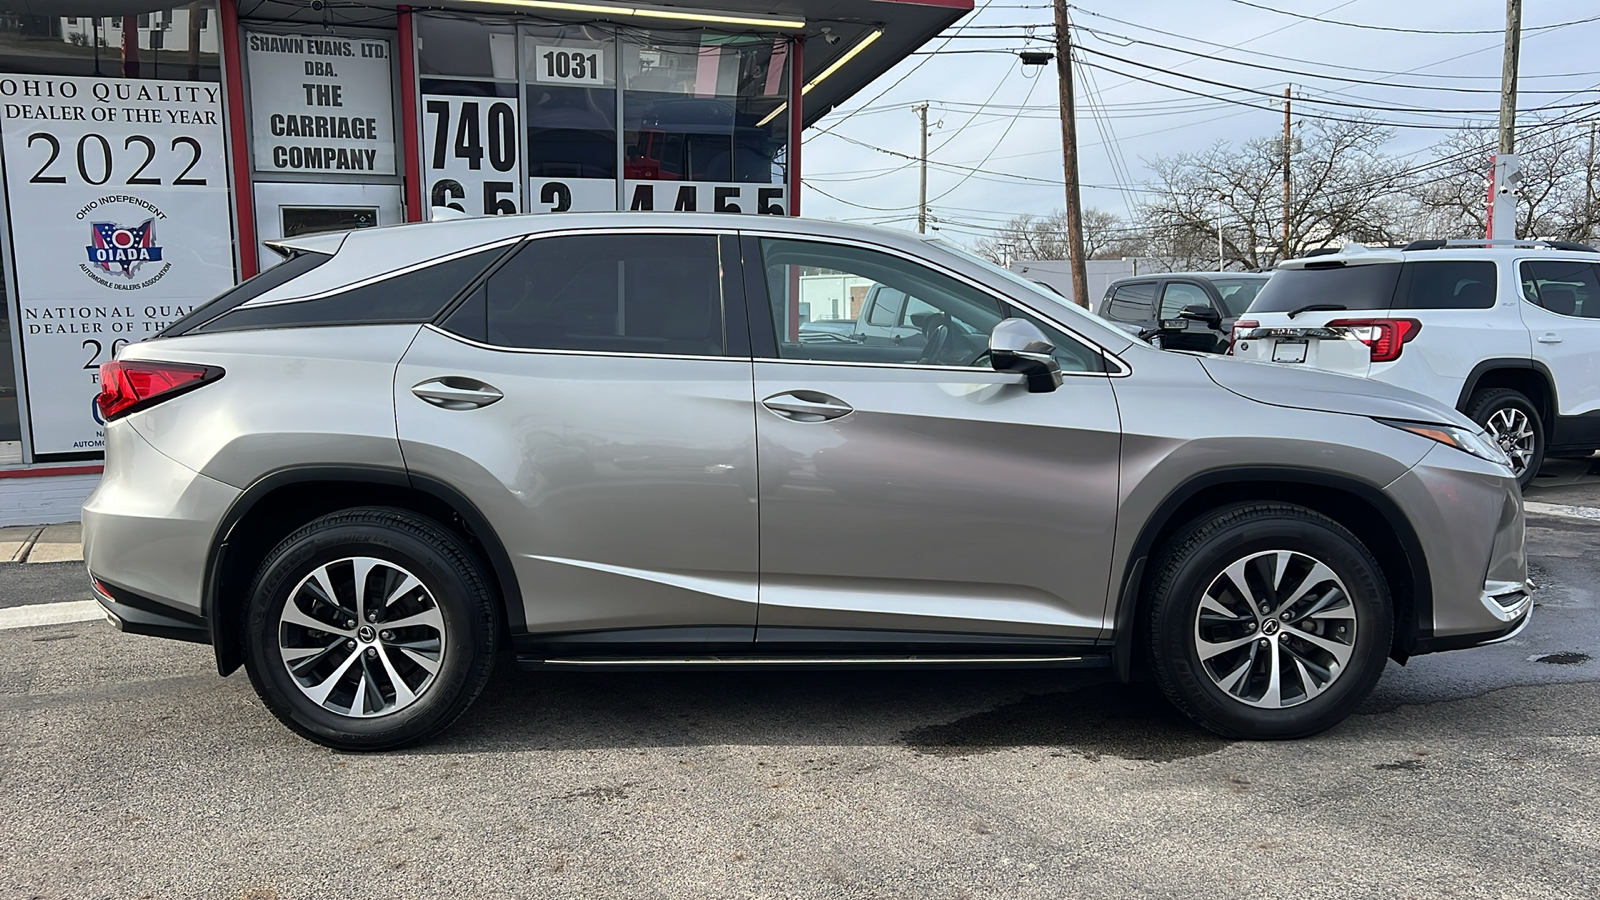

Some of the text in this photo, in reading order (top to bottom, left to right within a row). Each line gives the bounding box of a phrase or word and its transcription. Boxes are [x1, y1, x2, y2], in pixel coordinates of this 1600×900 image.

[250, 36, 388, 59] SHAWN EVANS. LTD.
[304, 61, 338, 77] DBA.
[543, 51, 598, 80] 1031
[1, 79, 218, 103] OHIO QUALITY
[302, 83, 343, 107] THE
[5, 104, 218, 125] DEALER OF THE YEAR
[270, 114, 377, 140] CARRIAGE
[426, 100, 516, 173] 740
[27, 132, 207, 186] 2022
[273, 146, 377, 171] COMPANY
[76, 195, 167, 221] OHIO INDEPENDENT
[96, 248, 150, 261] OIADA
[79, 262, 172, 291] AUTOMOBILE DEALERS ASSOCIATION
[25, 306, 135, 320] NATIONAL
[29, 321, 174, 335] DEALER OF TH
